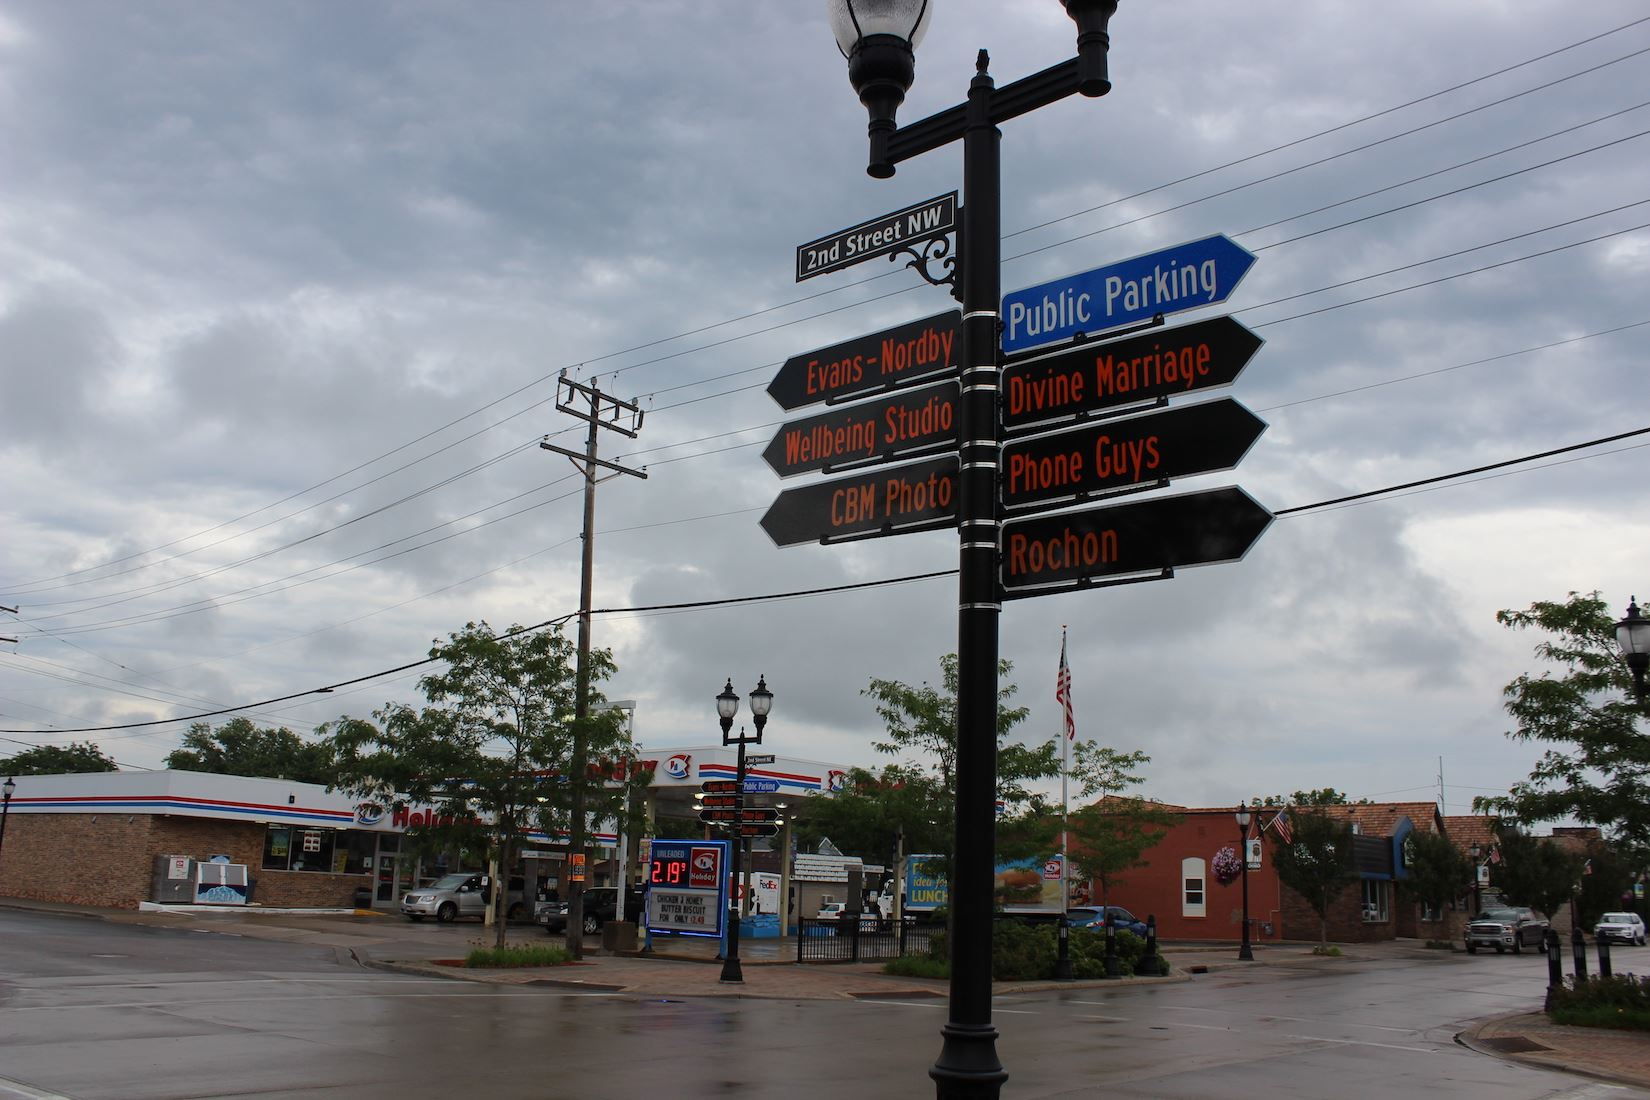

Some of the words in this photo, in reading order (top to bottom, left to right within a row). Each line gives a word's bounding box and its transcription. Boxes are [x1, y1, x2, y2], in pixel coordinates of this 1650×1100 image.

[807, 241, 840, 270] 2nd
[846, 220, 902, 256] Street
[908, 205, 943, 236] NW
[1010, 291, 1091, 340] Public
[1106, 259, 1217, 316] Parking
[1009, 370, 1085, 416] Divine
[1095, 342, 1211, 399] Marriage
[785, 420, 877, 465] Wellbeing
[884, 396, 954, 445] Studio
[1009, 449, 1084, 494] Phone
[1095, 434, 1161, 481] Guys
[831, 483, 876, 527] CBM
[886, 473, 952, 516] Photo
[1010, 527, 1118, 576] Rochon
[656, 849, 685, 858] UNLEADED
[661, 904, 681, 913] BUTTER
[683, 905, 706, 915] BISCUIT
[686, 896, 703, 905] HONEY
[760, 879, 777, 889] FedEx
[674, 914, 688, 924] ONLY
